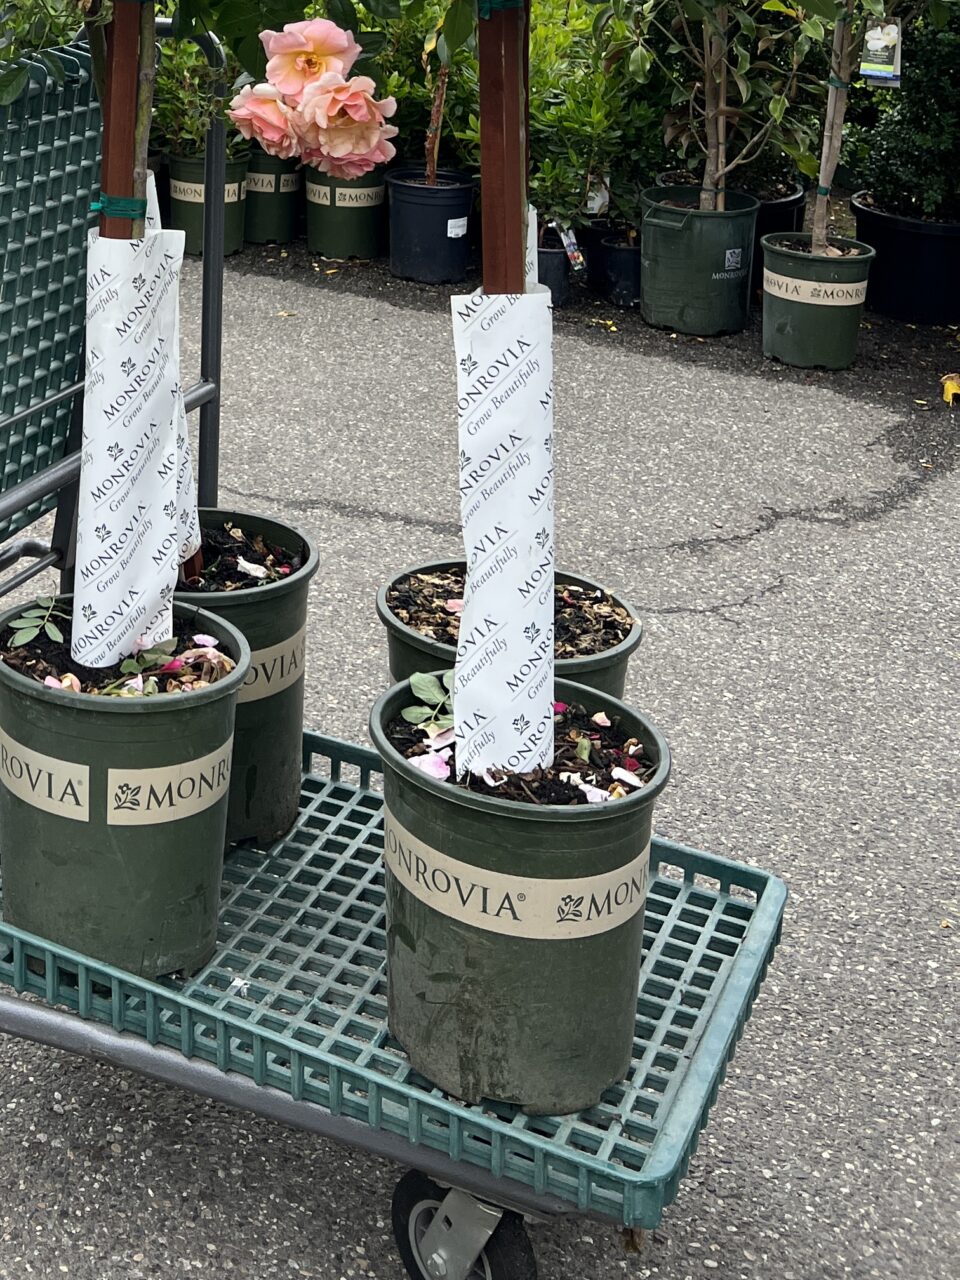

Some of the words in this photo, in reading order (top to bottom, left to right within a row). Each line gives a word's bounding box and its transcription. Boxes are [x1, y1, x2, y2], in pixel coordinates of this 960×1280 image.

[86, 287, 119, 322] eautifully
[115, 253, 174, 338] MONROVIA
[134, 319, 152, 345] Grow
[151, 269, 179, 320] Beautifully
[480, 303, 506, 332] Grow
[103, 337, 165, 422] MONROVIA
[122, 401, 142, 428] Grow
[142, 352, 170, 403] Beautifully
[467, 409, 491, 436] Grow
[490, 358, 540, 410] Beautifully
[90, 421, 157, 504] MONROVIA
[109, 487, 130, 513] Grow
[129, 436, 161, 488] Beautifully
[480, 451, 531, 502] Beautifully
[80, 503, 147, 582] MONROVIA
[96, 571, 120, 593] Grow
[120, 518, 153, 573] Beautifully
[470, 545, 519, 596] Beautifully
[71, 588, 139, 658] MONROVIA
[106, 604, 147, 652] Beautifully
[458, 637, 508, 688] Beautifully
[527, 671, 549, 700] Grow
